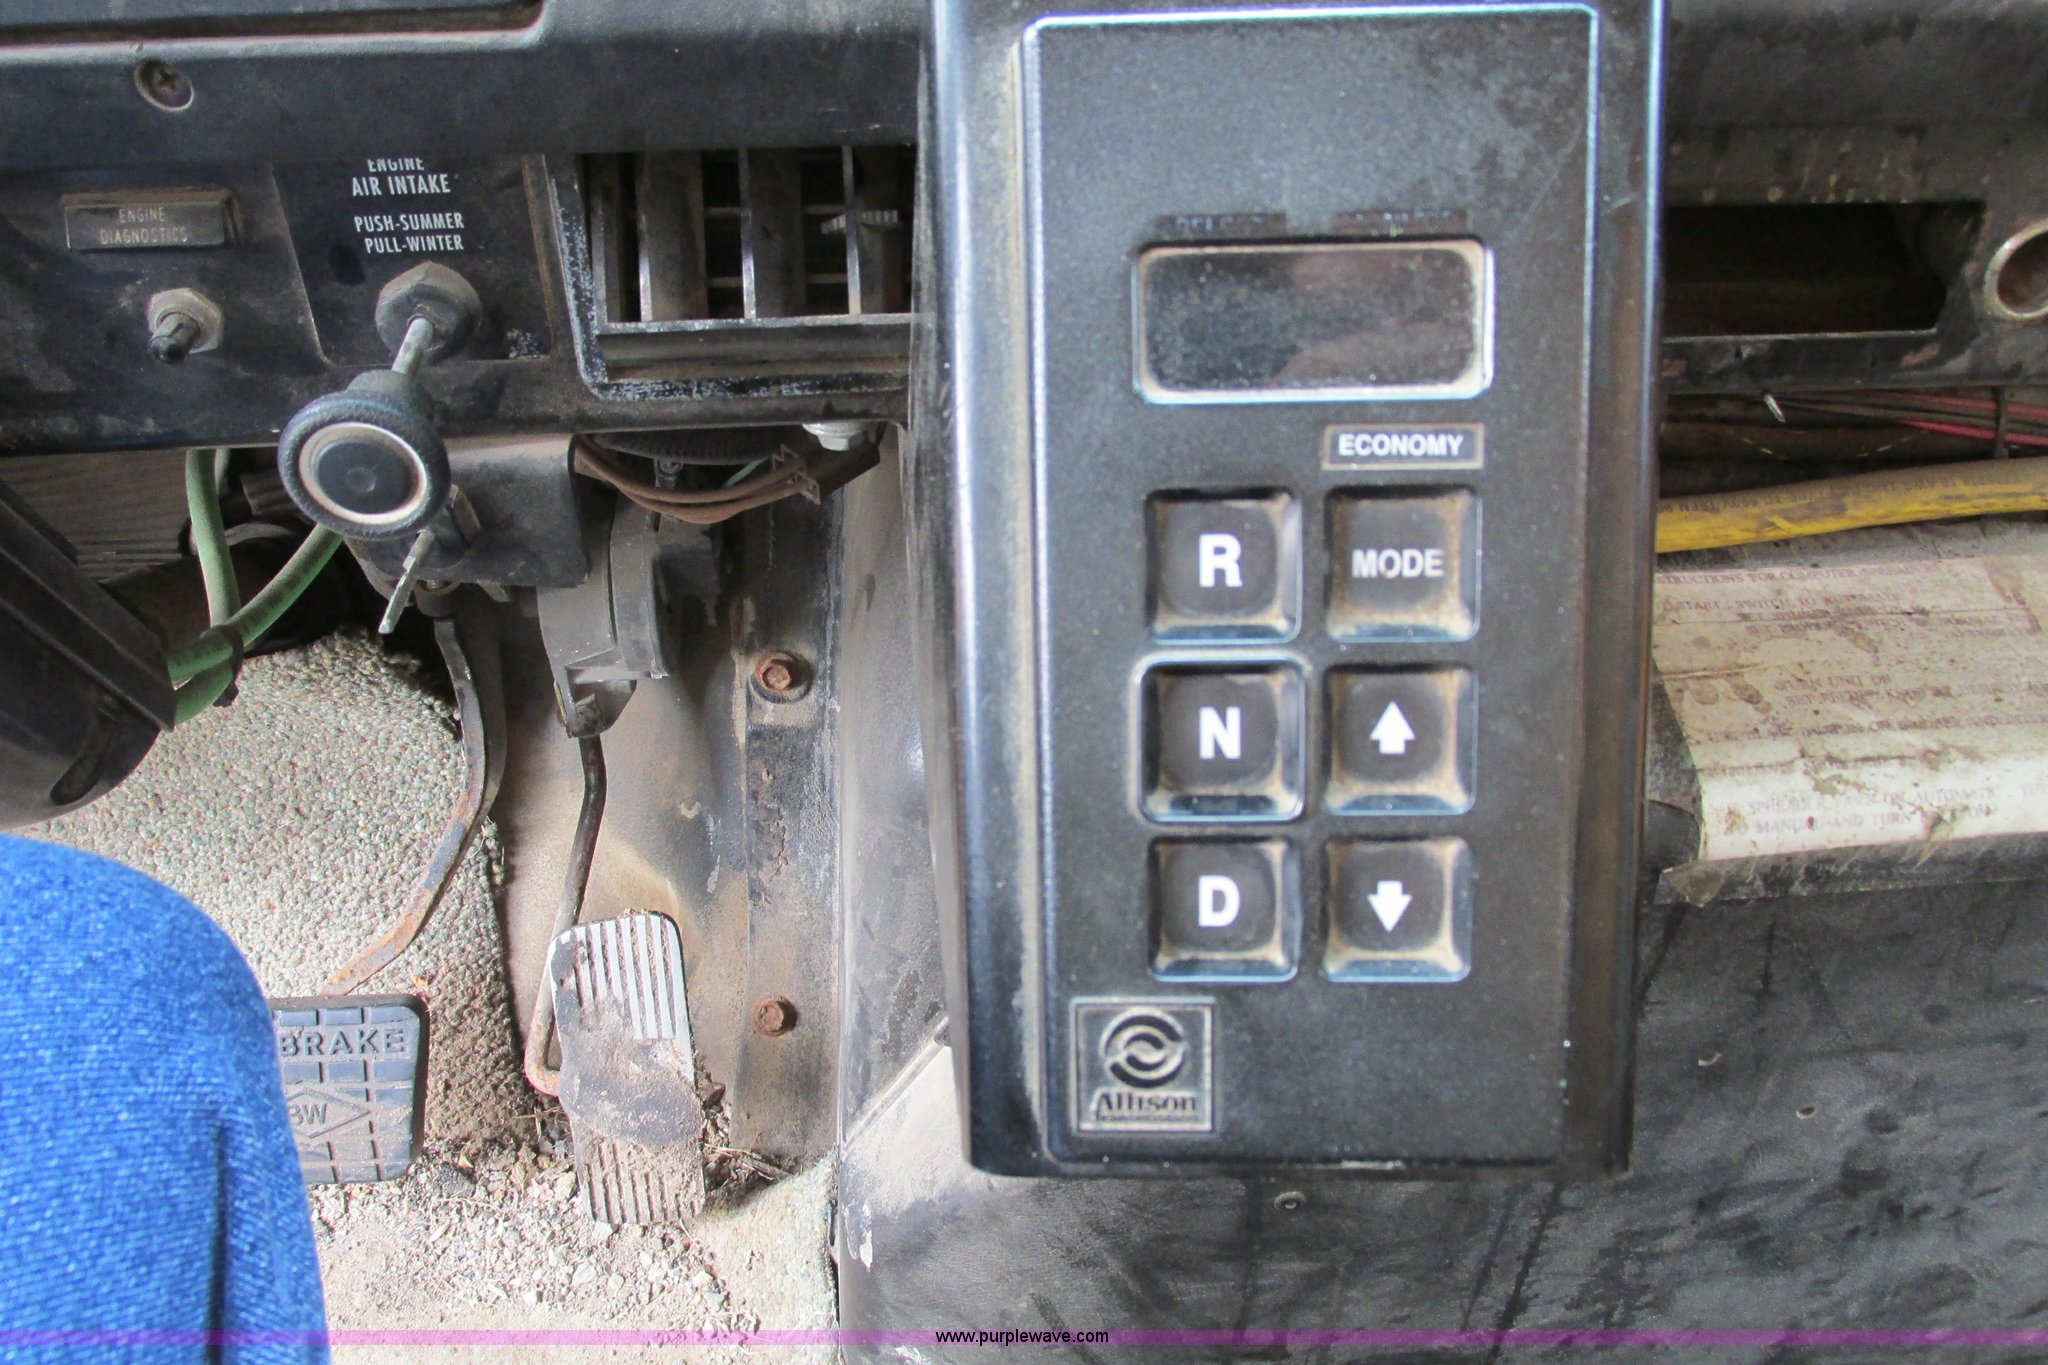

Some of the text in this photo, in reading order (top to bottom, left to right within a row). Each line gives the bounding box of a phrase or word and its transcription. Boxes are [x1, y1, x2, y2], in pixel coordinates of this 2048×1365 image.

[367, 158, 425, 172] ENGINE
[352, 173, 451, 197] AIR INTAKE
[119, 207, 168, 223] ENGINE
[353, 212, 465, 232] PUSH-SUMMER
[101, 227, 188, 245] DIAGNOSTICS
[364, 235, 464, 253] PULL-WINTER
[1338, 433, 1464, 456] ECONOMY
[1199, 533, 1243, 588] R
[1351, 548, 1445, 579] MODE
[1199, 706, 1241, 760] N
[1198, 875, 1240, 928] D
[278, 1028, 405, 1057] BRAKE
[1096, 1092, 1196, 1116] Allison
